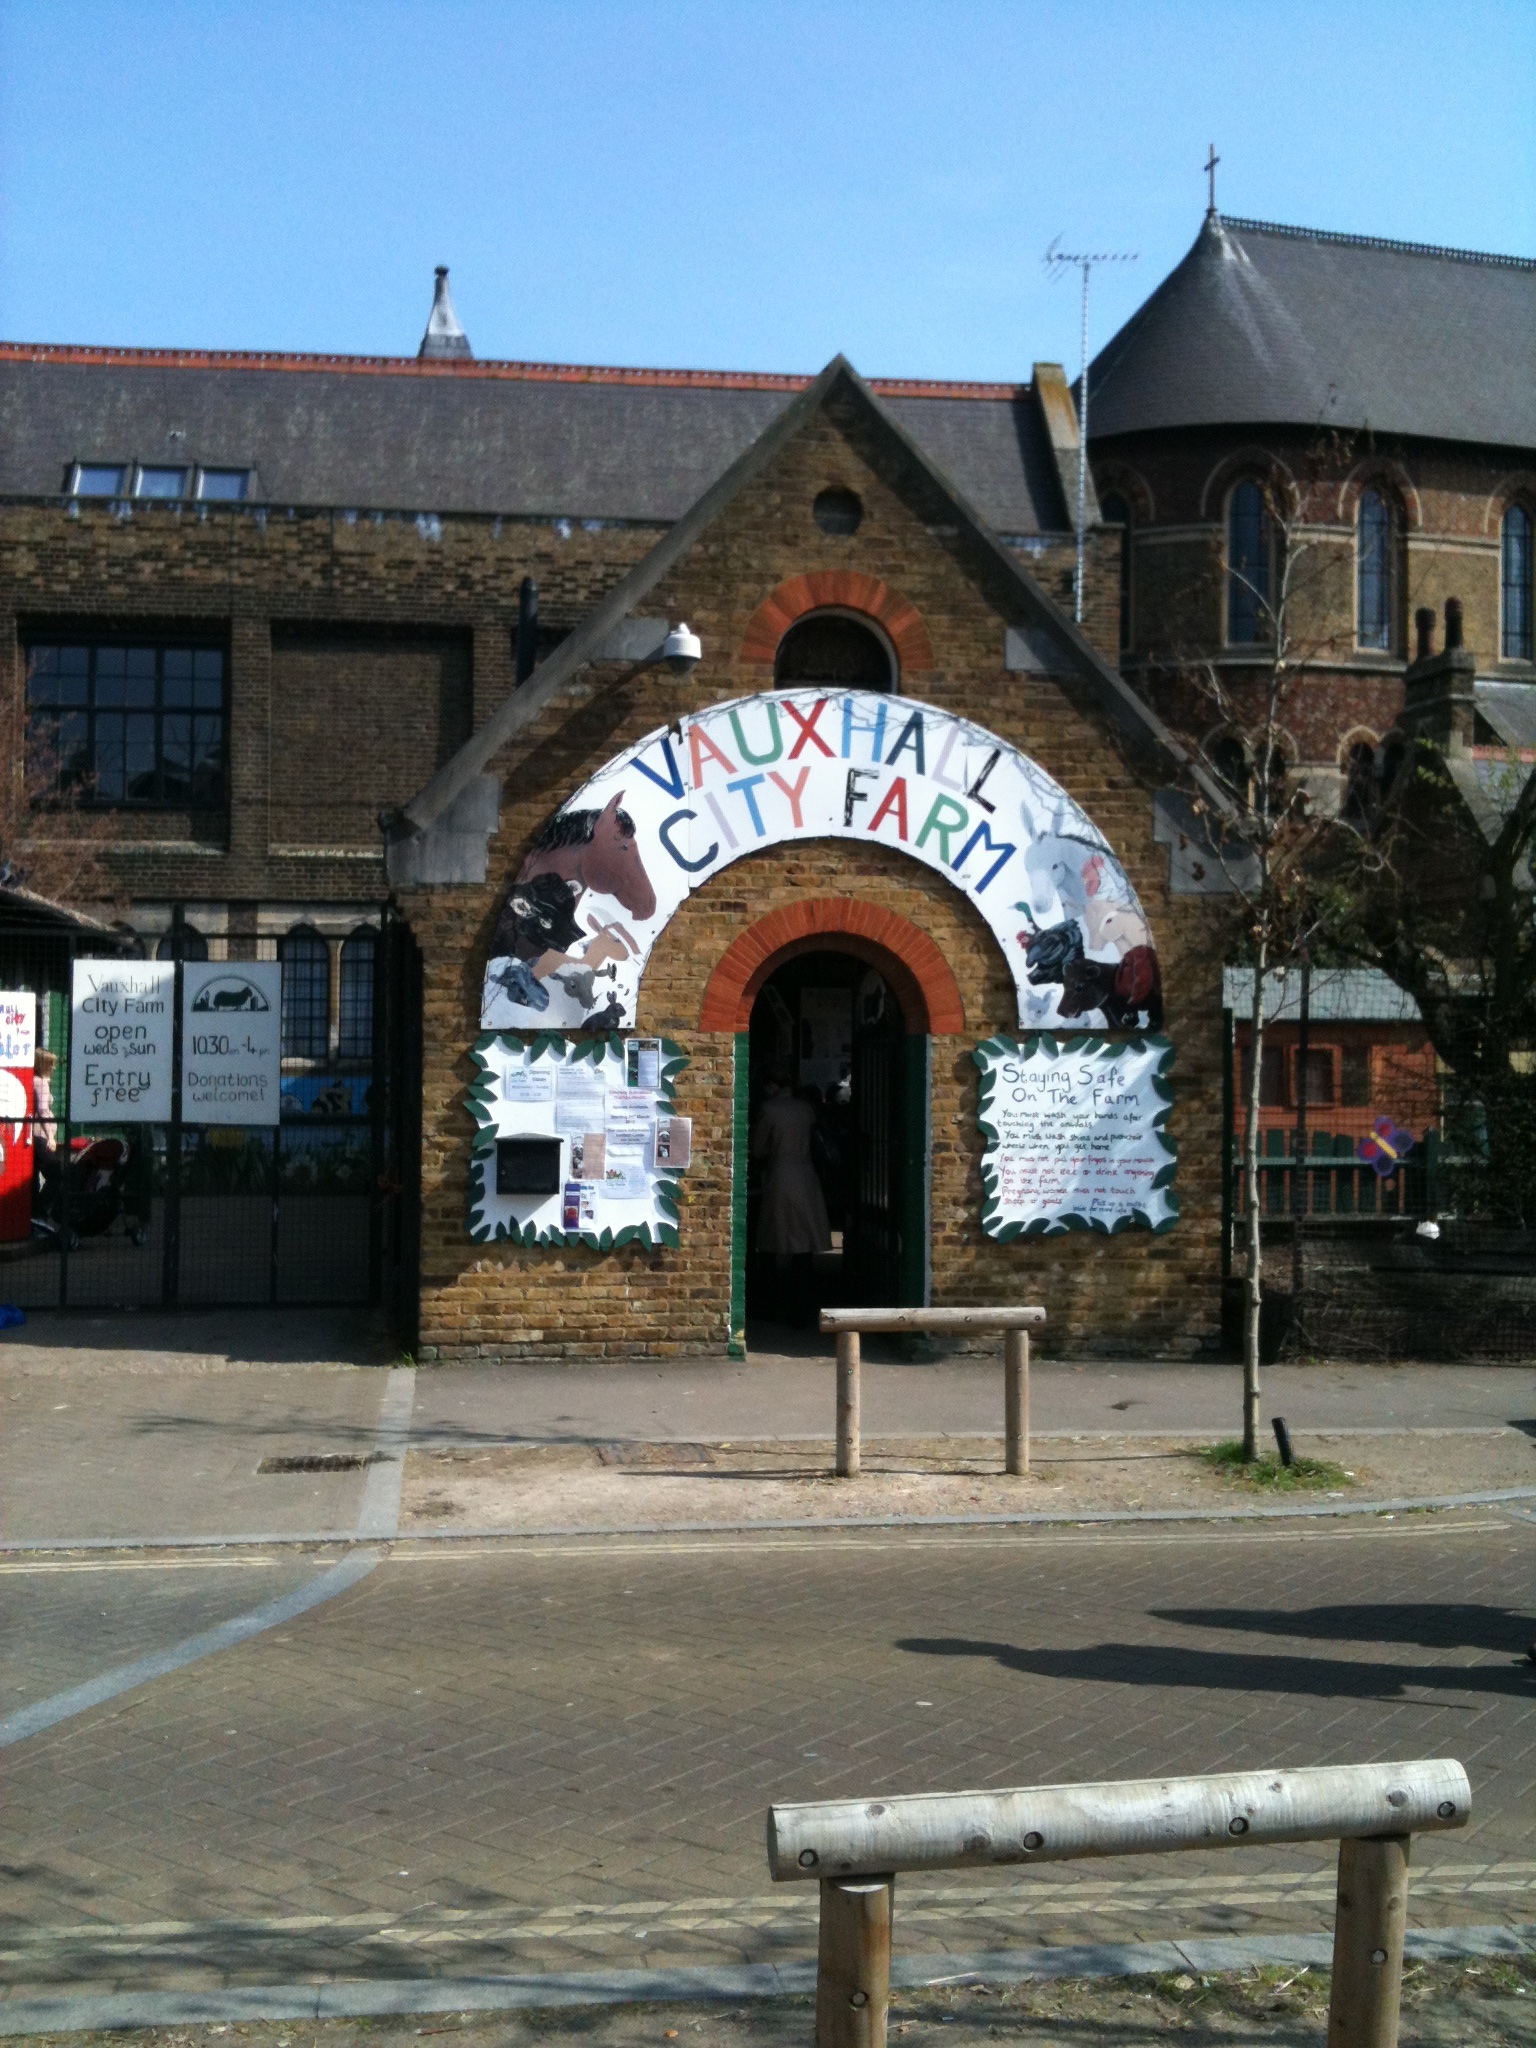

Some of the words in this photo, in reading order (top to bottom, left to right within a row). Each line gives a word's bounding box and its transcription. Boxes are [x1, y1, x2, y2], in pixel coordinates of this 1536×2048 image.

[630, 698, 1002, 813] VAUXHALL
[658, 764, 812, 872] CITY
[843, 767, 1017, 895] FARM
[87, 974, 160, 994] Vauxhall
[124, 998, 164, 1014] Farm
[95, 1025, 147, 1042] open
[84, 1040, 118, 1055] weds
[85, 1063, 151, 1090] Entry
[188, 1072, 268, 1087] Donations
[1002, 1063, 1071, 1093] Staying
[1077, 1065, 1125, 1088] Safe
[91, 1086, 140, 1107] free
[1012, 1087, 1037, 1103] On
[1047, 1089, 1077, 1104] The
[1093, 1088, 1139, 1106] Farm
